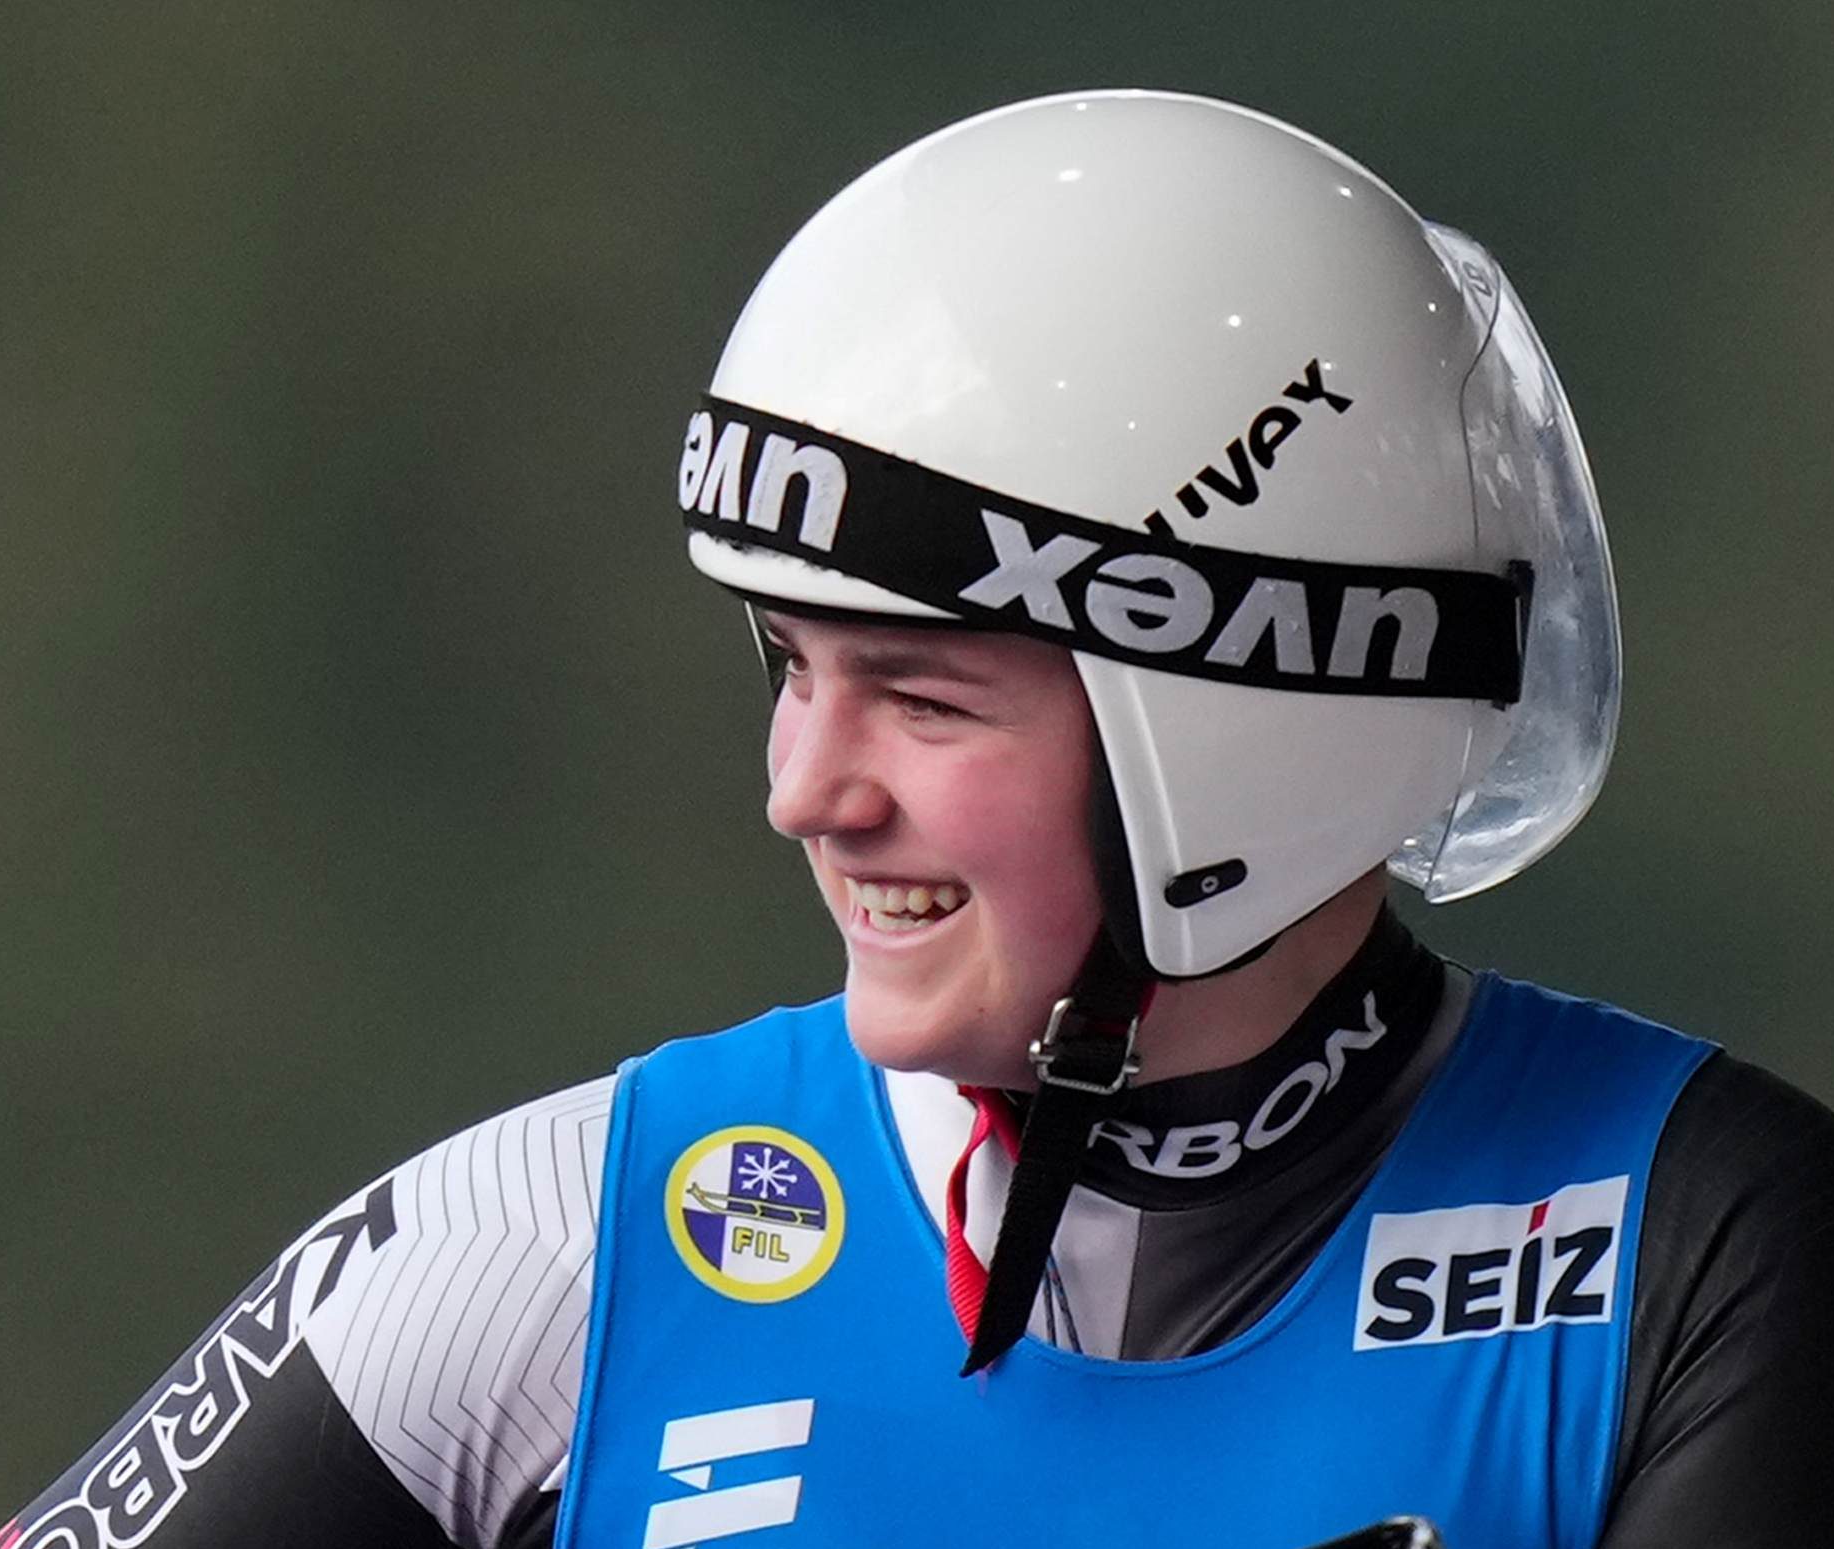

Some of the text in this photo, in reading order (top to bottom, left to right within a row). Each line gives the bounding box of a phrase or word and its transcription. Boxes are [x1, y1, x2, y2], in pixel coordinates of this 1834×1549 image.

[679, 411, 850, 552] uve
[958, 508, 1439, 680] uvex
[1087, 990, 1387, 1178] RBON
[731, 1226, 790, 1263] FIL
